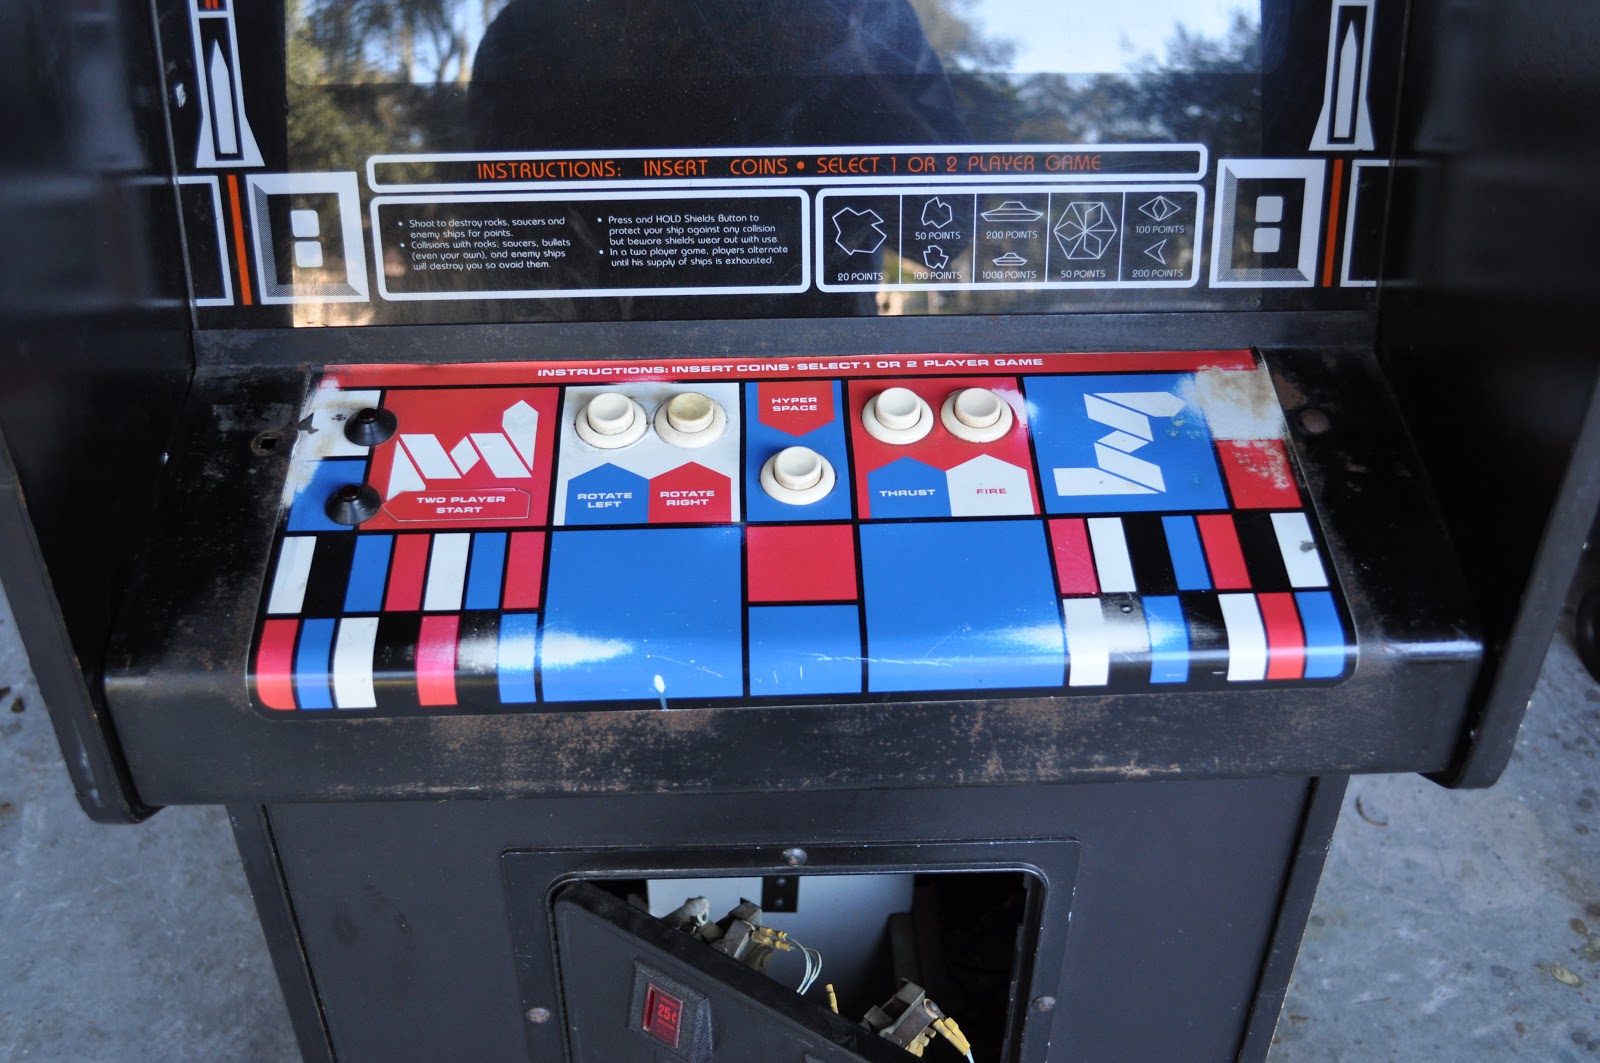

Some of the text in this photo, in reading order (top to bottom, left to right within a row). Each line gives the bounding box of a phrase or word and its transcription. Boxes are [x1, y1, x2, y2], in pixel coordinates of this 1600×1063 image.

[477, 154, 1101, 180] INSTRUCTIONS: INSERT COINS SELECT 1 OR 2 PLAYER GAME
[409, 219, 435, 228] Shoot
[448, 218, 483, 228] destroy
[547, 217, 565, 225] and
[608, 213, 760, 224] Press and HOLD Shields Button to
[410, 229, 513, 240] enemy ships for points.
[609, 224, 776, 236] protect your ship against any collision
[1135, 225, 1185, 234] 100 POINTS
[609, 237, 624, 245] but
[627, 237, 662, 245] beware
[665, 236, 695, 244] shields
[724, 236, 738, 244] out
[741, 235, 759, 243] with
[915, 231, 961, 241] 50 POINTS
[986, 230, 1038, 240] 200 POINTS
[411, 240, 450, 249] Collisions
[453, 240, 471, 249] with
[542, 238, 571, 247] bullets
[412, 252, 438, 261] (even
[440, 253, 460, 261] your
[490, 250, 508, 258] and
[511, 251, 540, 259] enemy
[543, 249, 566, 259] ships
[610, 248, 618, 256] In
[629, 248, 647, 256] two
[649, 247, 677, 257] player
[712, 246, 745, 256] players
[747, 245, 788, 254] alternate
[430, 262, 463, 272] destroy
[466, 263, 483, 272] you
[485, 262, 496, 270] so
[499, 260, 523, 269] avoid
[526, 260, 551, 268] them.
[611, 256, 775, 268] until his supply of ships is exhausted.
[837, 272, 884, 282] 20 POINTS
[913, 271, 962, 280] 100 POINTS
[982, 270, 1037, 279] 1000 POINTS
[1061, 269, 1106, 278] 50 POINTS
[1132, 269, 1183, 278] 200 POINTS
[537, 366, 669, 377] INSTRUCTIONS:
[672, 365, 734, 373] INSERT
[736, 363, 790, 372] COINS
[797, 362, 861, 371] SELECT
[876, 361, 901, 369] OR
[907, 360, 917, 368] 2
[924, 359, 989, 368] PLAYER
[577, 492, 633, 500] ROTATE
[659, 490, 715, 498] ROTATE
[879, 489, 936, 497] THRUST
[436, 506, 483, 514] START
[587, 501, 622, 509] LEFT
